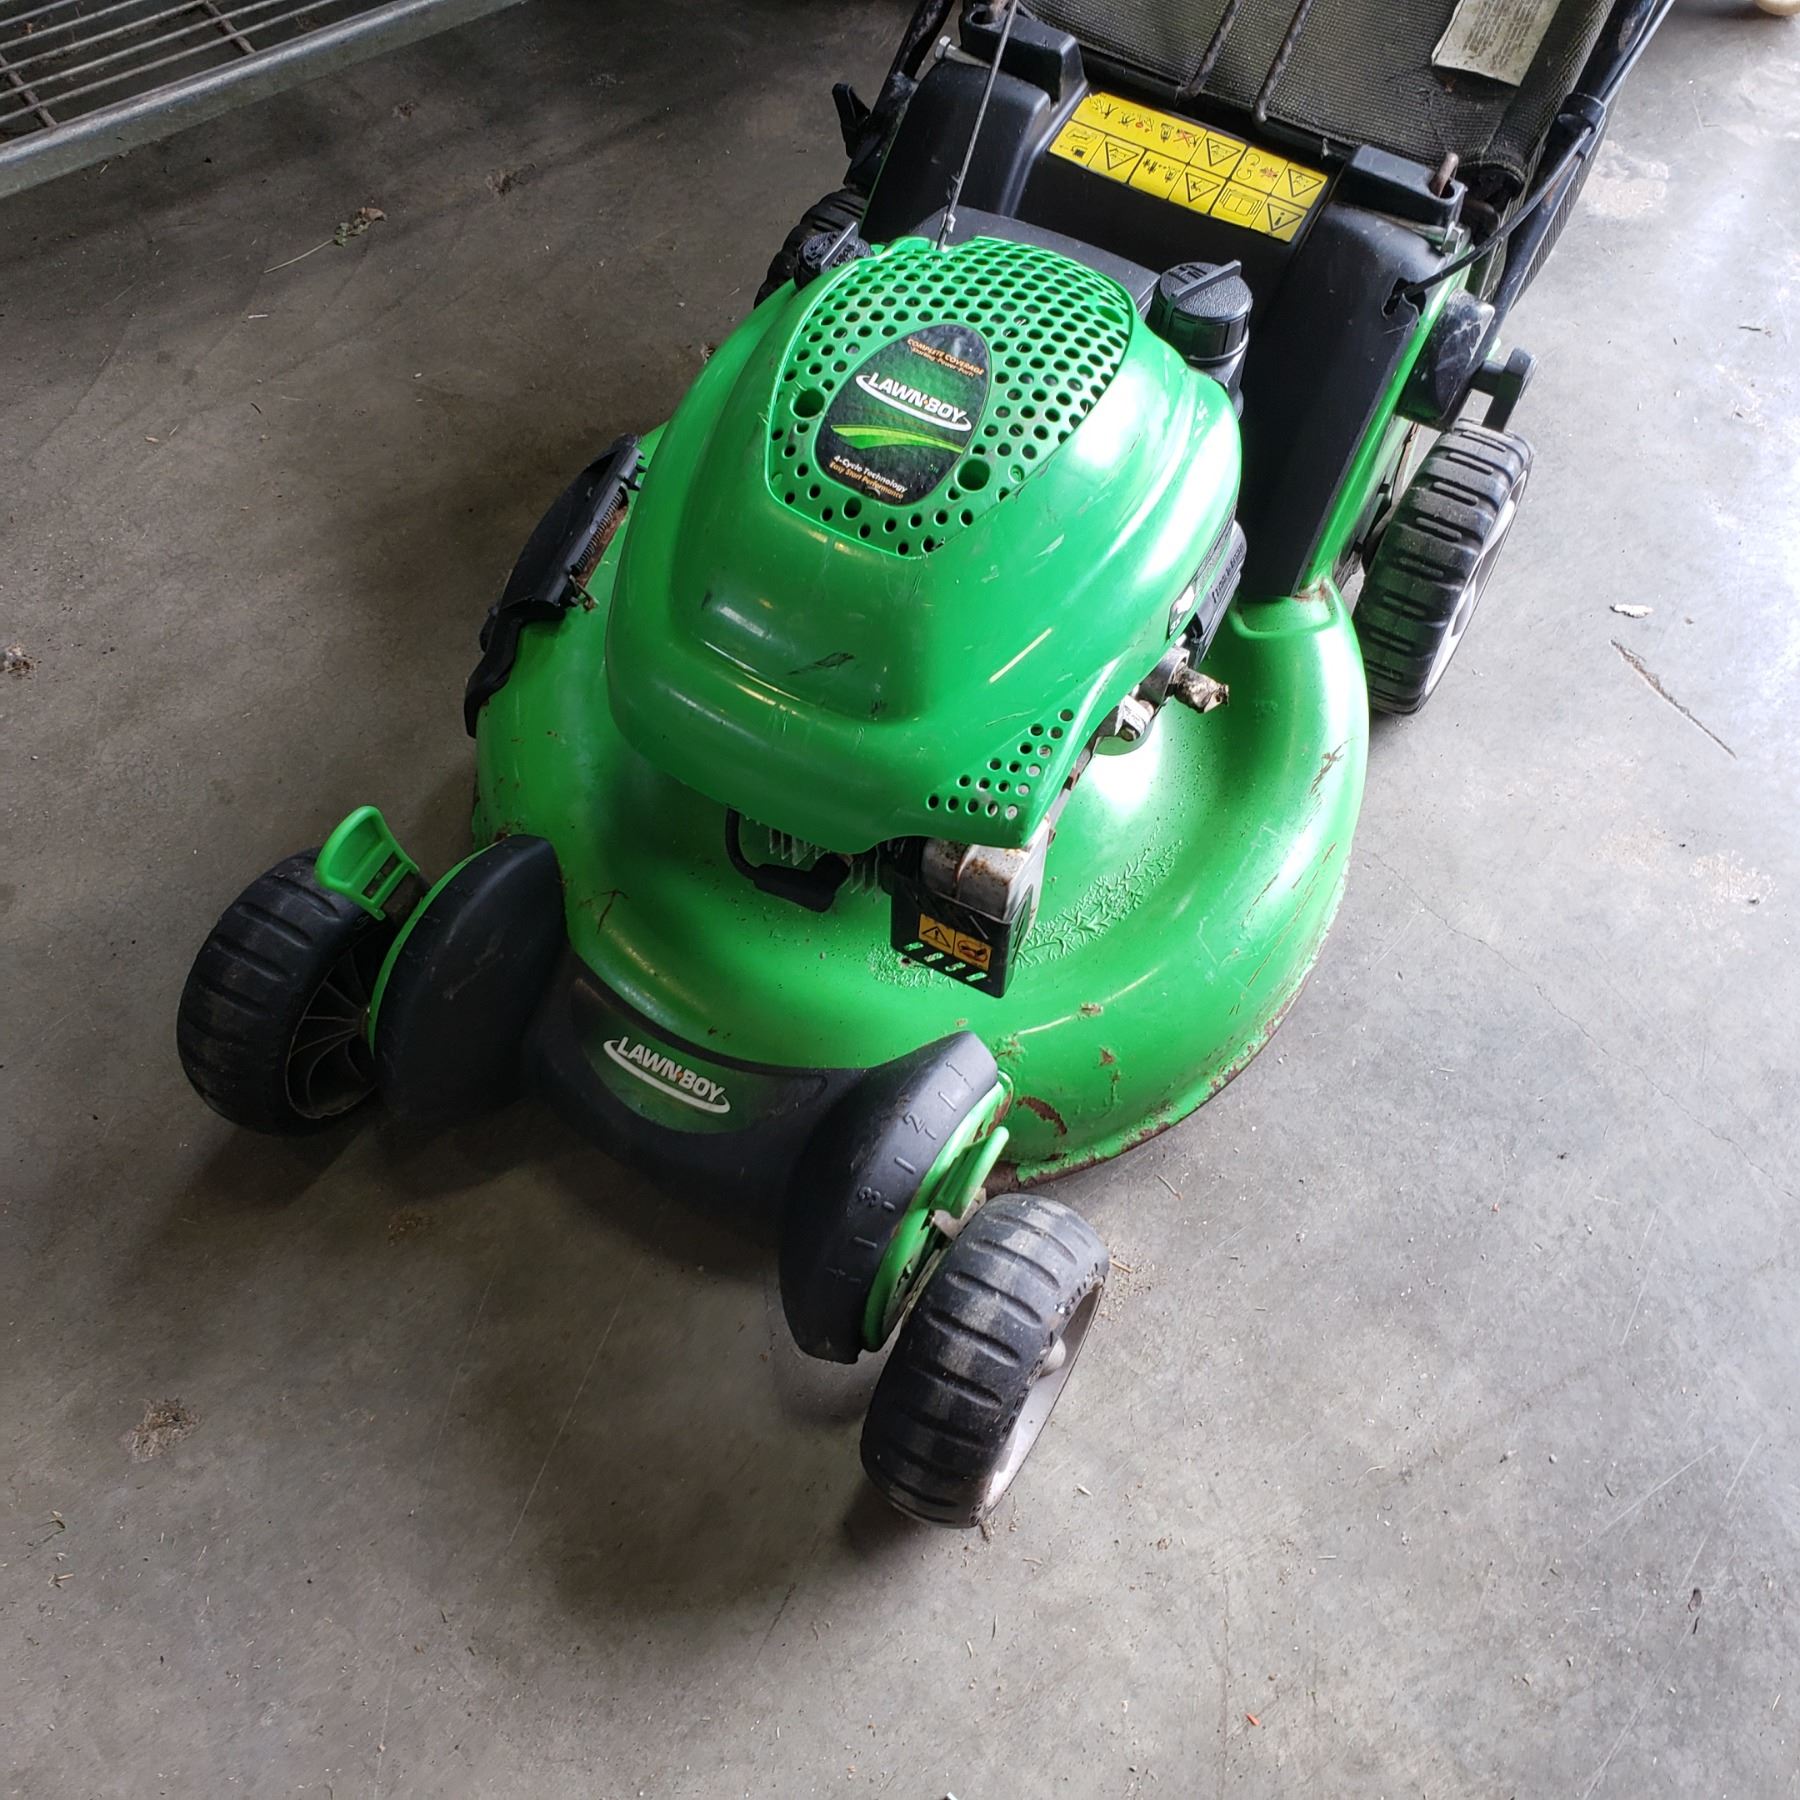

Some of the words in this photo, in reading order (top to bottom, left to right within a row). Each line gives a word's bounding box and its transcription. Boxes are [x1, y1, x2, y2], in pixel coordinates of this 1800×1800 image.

[907, 338, 946, 357] COMPLETE
[944, 354, 985, 375] COVERAGE
[829, 461, 846, 475] Easy
[845, 467, 863, 481] Start
[861, 475, 904, 499] Performance
[833, 455, 863, 473] 4-Cycle
[863, 466, 908, 493] Technology
[903, 1112, 925, 1135] 2
[858, 1186, 882, 1207] 3
